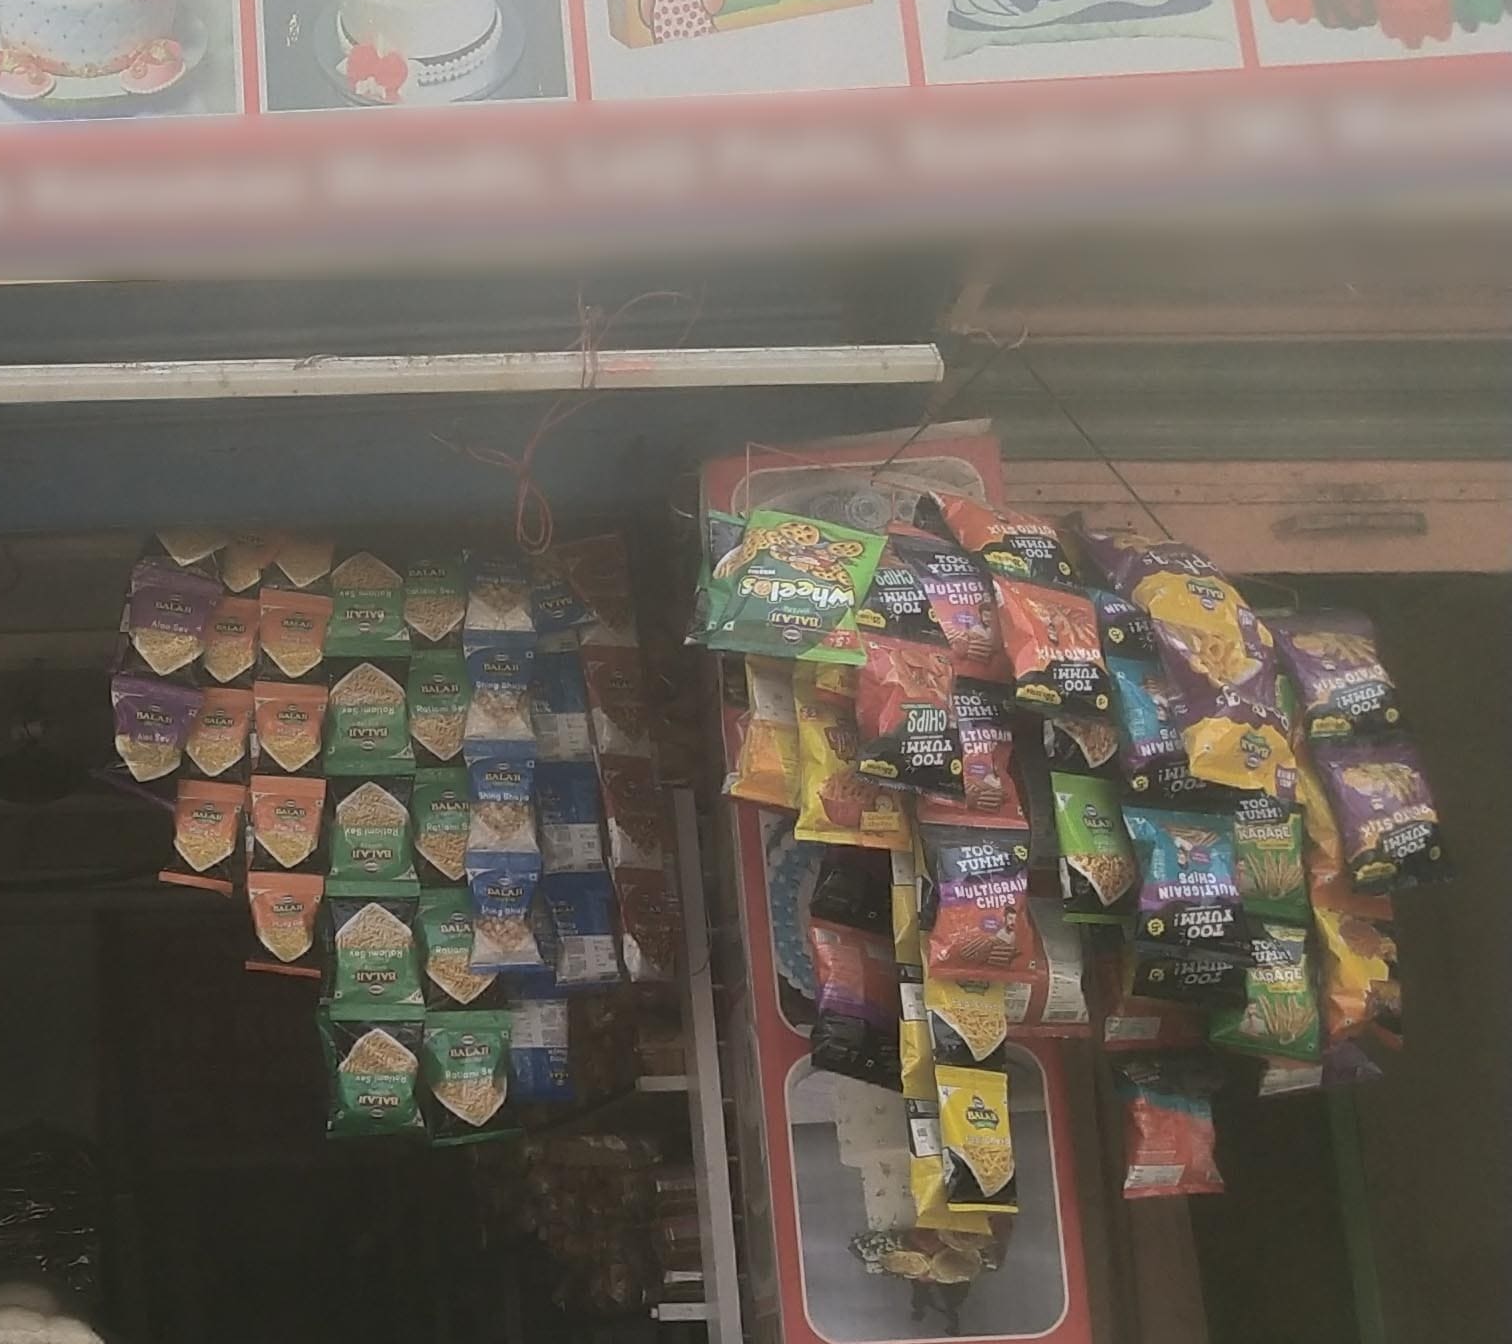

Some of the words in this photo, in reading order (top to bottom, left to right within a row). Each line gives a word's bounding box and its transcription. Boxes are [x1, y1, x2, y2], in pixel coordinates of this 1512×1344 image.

[1025, 549, 1053, 558] TOO
[893, 603, 922, 614] TOO
[1053, 668, 1100, 679] YUMM!
[1064, 680, 1093, 691] TOO
[1350, 700, 1381, 715] TOO
[907, 714, 947, 732] CHIPS
[900, 740, 953, 753] YUMM!
[911, 755, 944, 766] TOO
[1240, 798, 1269, 809] TOO
[1237, 807, 1282, 820] YUMM!
[1238, 826, 1291, 841] KARARE
[961, 846, 994, 858] TOO
[1397, 840, 1427, 857] TOO
[956, 853, 1010, 872] YUMM!
[1179, 872, 1217, 884] CHIPS
[954, 878, 1028, 899] MULTIGRAIN
[1159, 885, 1239, 900] MULTIGRAIN
[976, 894, 1016, 909] CHIPS
[1173, 908, 1235, 926] YUMM!
[1187, 925, 1225, 938] TOO
